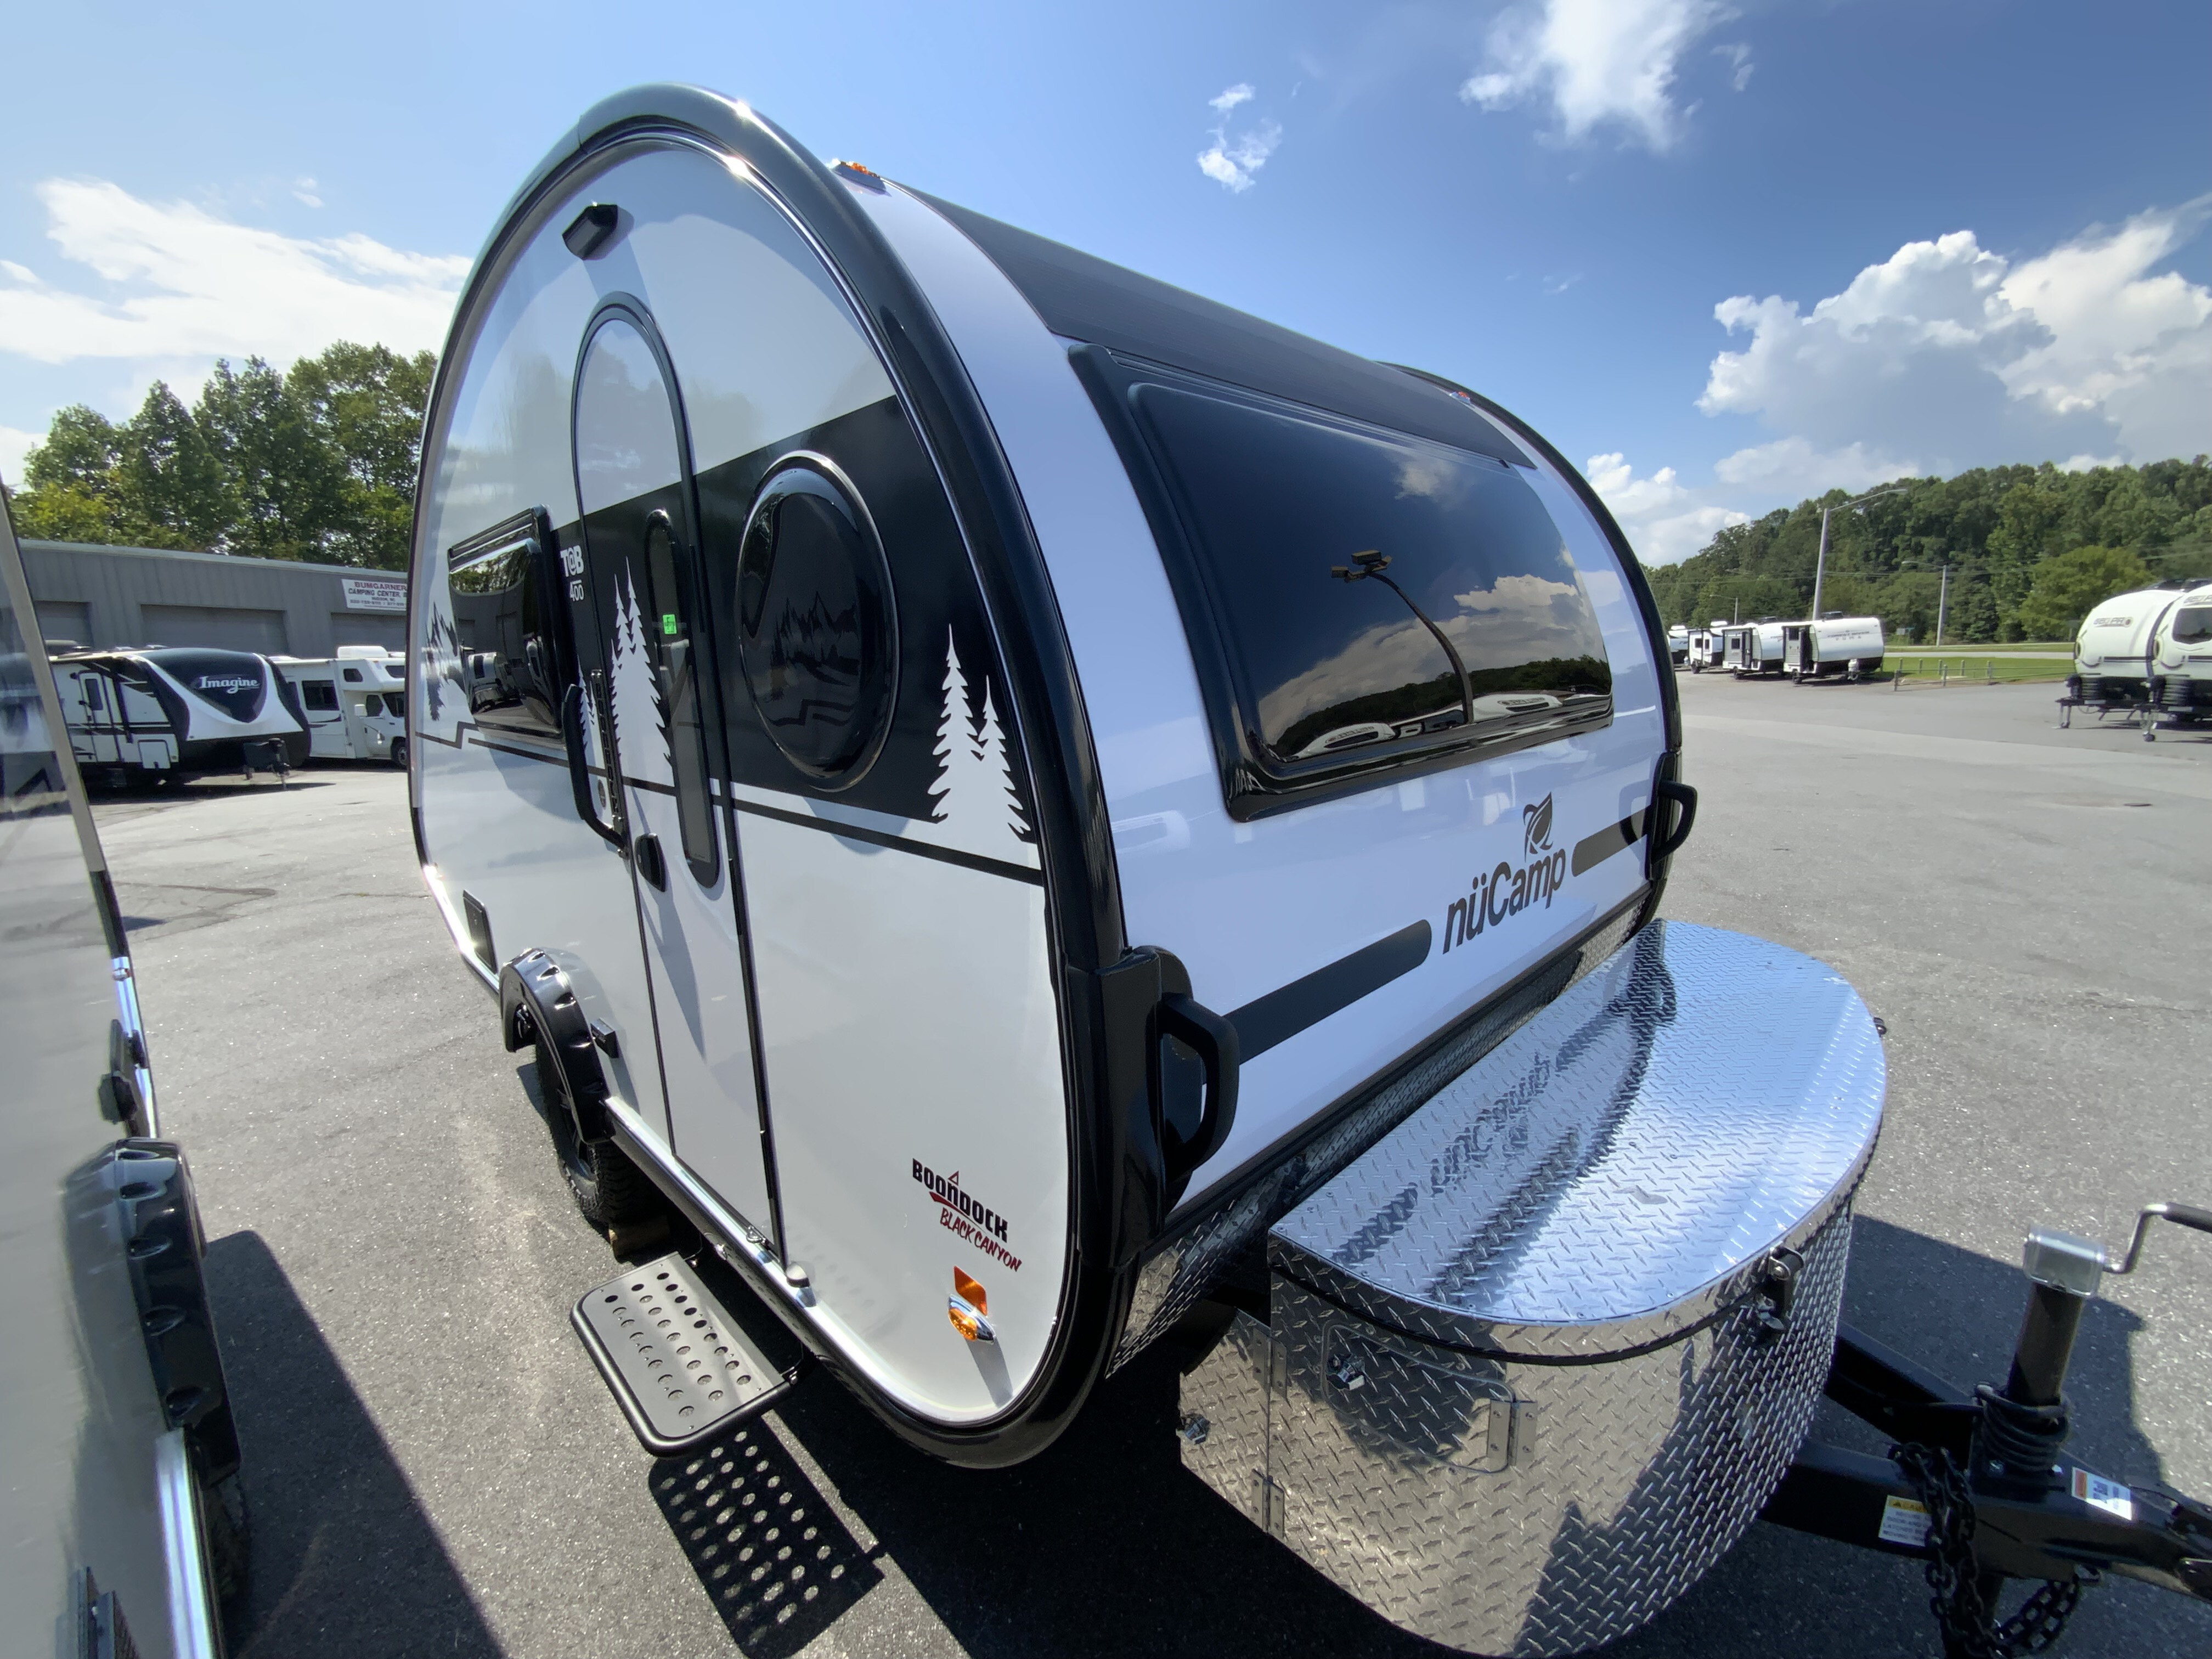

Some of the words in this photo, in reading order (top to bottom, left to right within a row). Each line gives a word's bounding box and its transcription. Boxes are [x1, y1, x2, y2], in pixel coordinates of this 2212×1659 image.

[560, 545, 584, 577] T@B
[569, 580, 584, 602] 400
[199, 676, 259, 694] Imagine
[1442, 848, 1566, 955] nüCamp
[940, 1207, 976, 1244] BLACK
[974, 1231, 1022, 1272] CANYON
